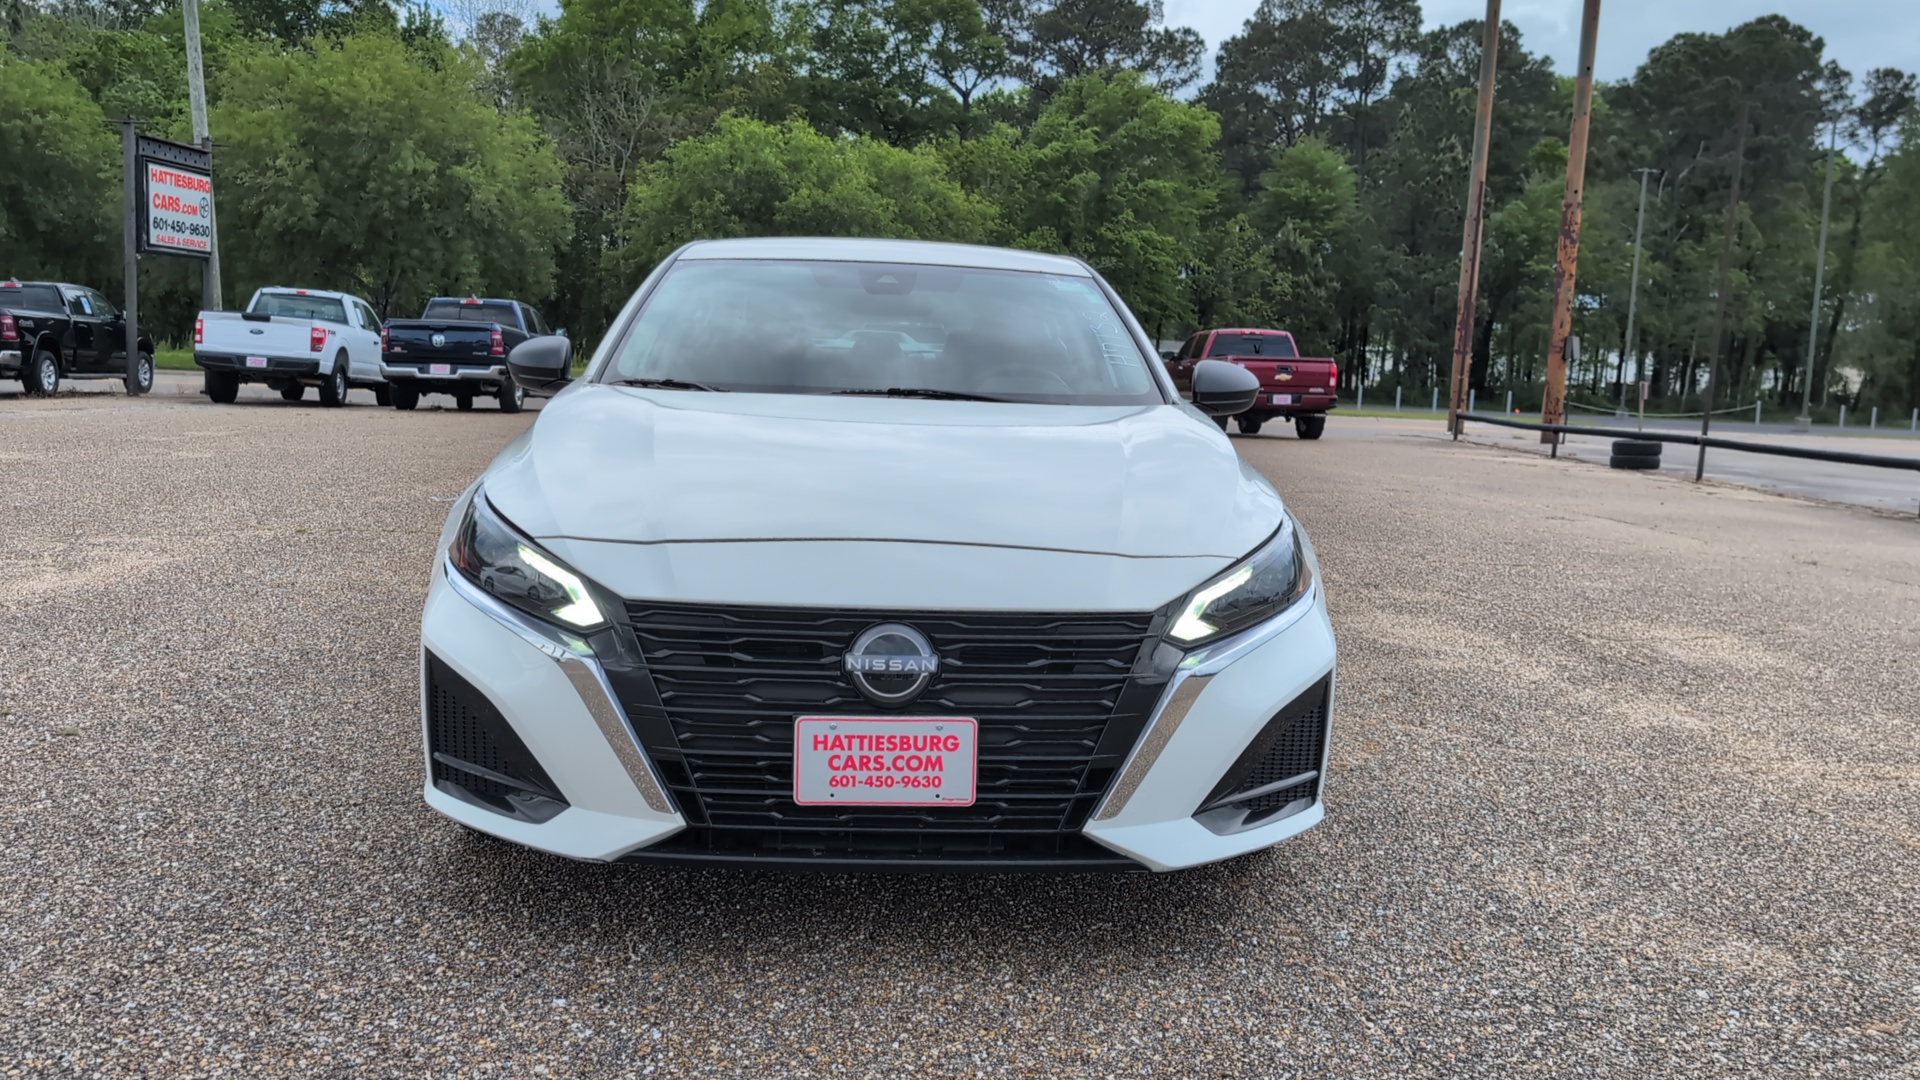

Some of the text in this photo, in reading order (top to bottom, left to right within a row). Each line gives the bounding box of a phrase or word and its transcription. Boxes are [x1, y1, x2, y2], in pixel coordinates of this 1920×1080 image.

[151, 168, 211, 193] HATTIESBURG
[153, 217, 210, 238] 601-450-9630
[156, 234, 176, 245] SALES
[182, 238, 207, 250] SERVICE
[847, 658, 935, 671] NISSAN
[813, 734, 960, 752] HATTIESBURG
[828, 755, 943, 772] CARS.COM
[829, 775, 942, 788] 601-450-9630
